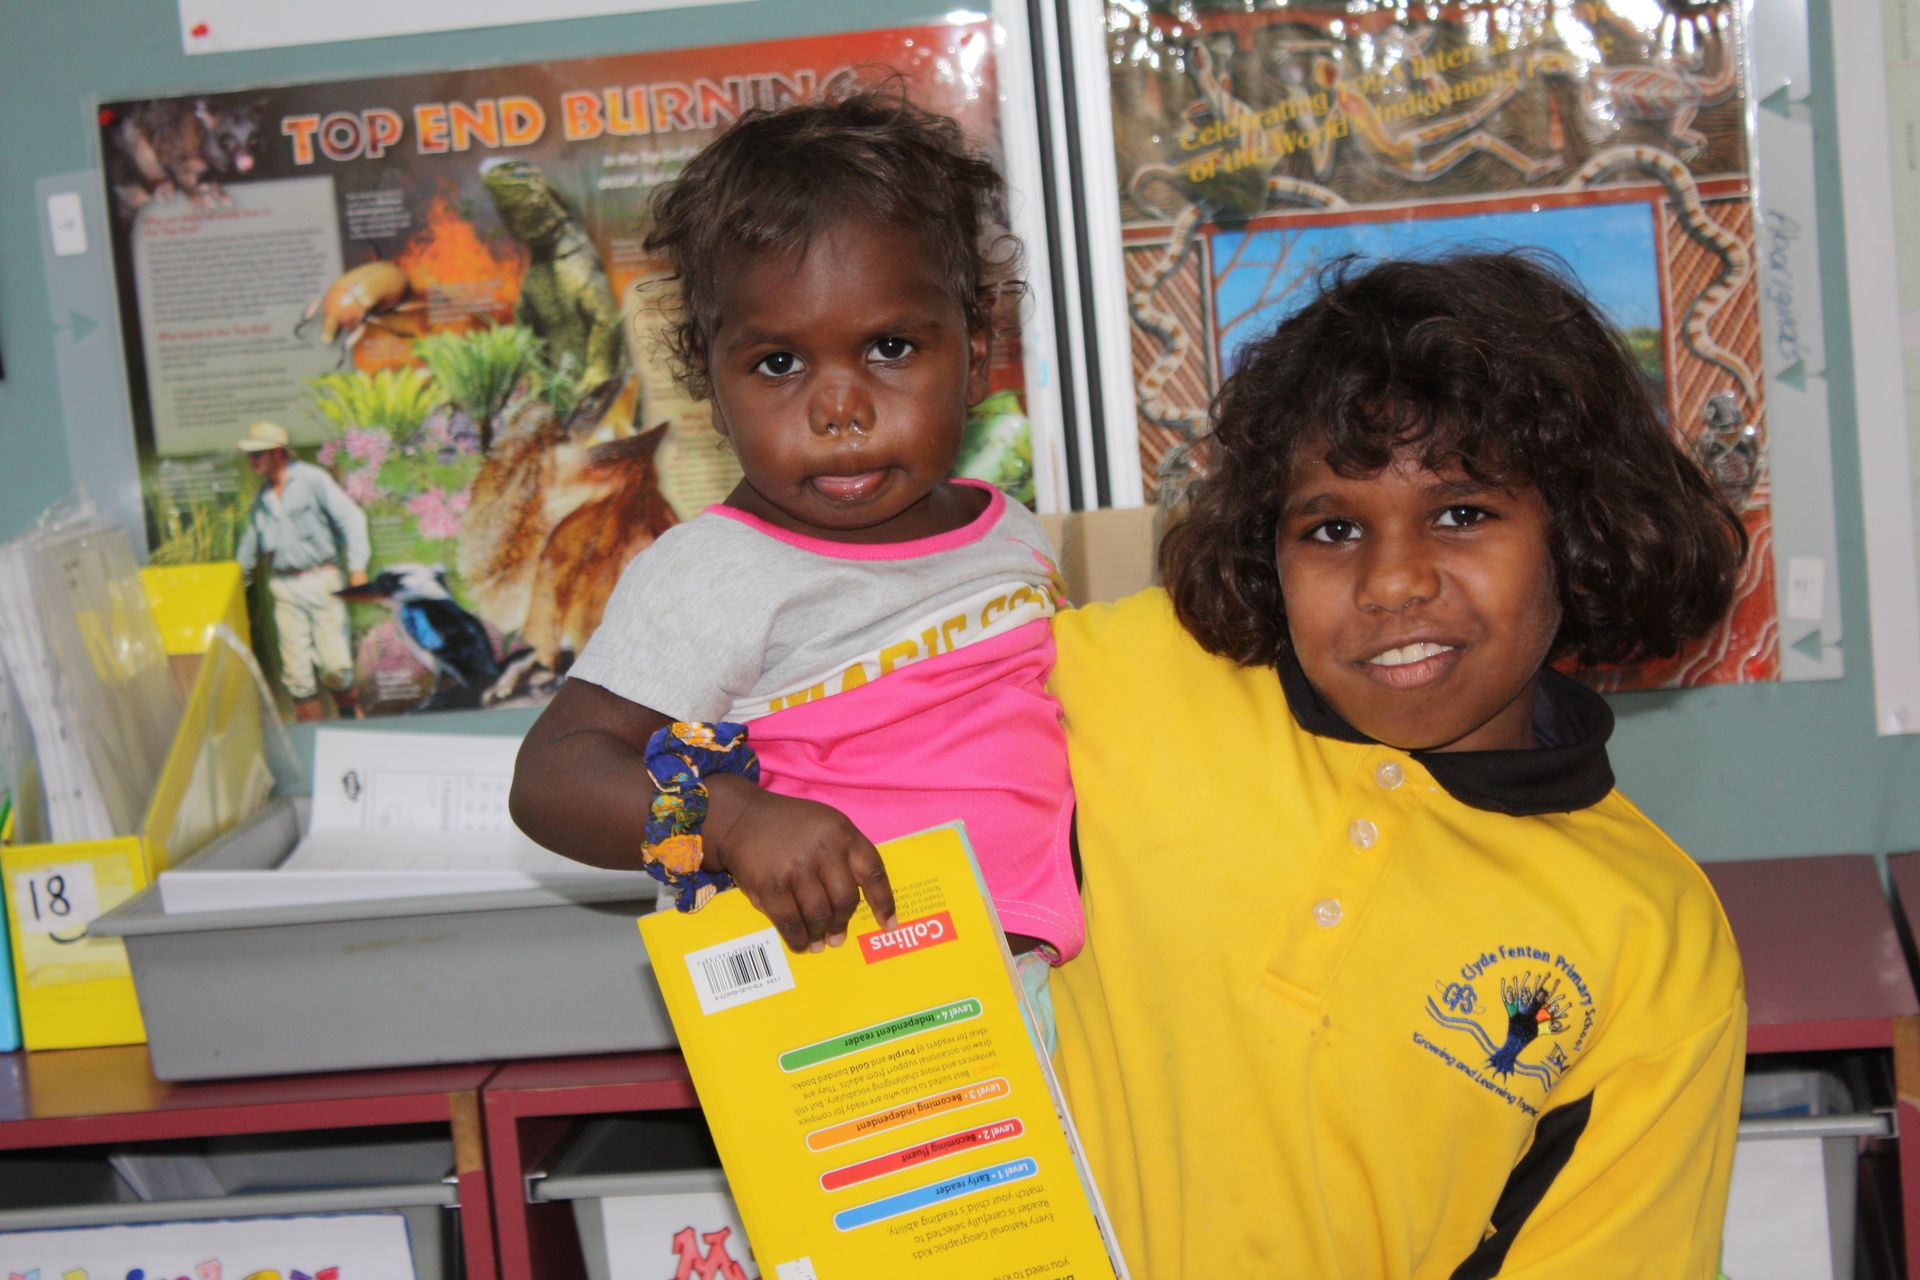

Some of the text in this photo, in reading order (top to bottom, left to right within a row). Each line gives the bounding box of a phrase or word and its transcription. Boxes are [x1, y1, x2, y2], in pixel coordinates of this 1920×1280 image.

[283, 110, 403, 164] TOP
[414, 98, 545, 154] END
[28, 874, 71, 921] 18
[870, 919, 943, 950] Collins
[1461, 945, 1596, 1051] Clyde Fenton Primary School
[843, 1003, 973, 1048] Level 4 Independent reader
[968, 1026, 987, 1038] ideal
[925, 1036, 955, 1051] readers
[957, 1031, 968, 1042] for
[914, 1043, 925, 1054] of
[960, 1044, 971, 1052] on
[973, 1039, 992, 1050] draw
[870, 1056, 887, 1067] and
[888, 1048, 915, 1061] Purple
[918, 1047, 959, 1065] occasional
[849, 1061, 870, 1074] Gold
[886, 1058, 918, 1074] support
[1413, 1032, 1456, 1066] Growing
[1456, 1061, 1478, 1078] and
[1475, 1073, 1517, 1105] Learning
[817, 1068, 848, 1083] banded
[865, 1067, 885, 1081] from
[928, 1074, 953, 1088] suited
[952, 1069, 969, 1080] Best
[793, 1050, 995, 1116] sentences and more challenging vocabulary, but still
[816, 1082, 836, 1096] They
[918, 1081, 927, 1090] to
[804, 1090, 816, 1099] are
[883, 1090, 900, 1101] who
[901, 1085, 918, 1096] kids
[846, 1101, 868, 1112] ready
[856, 1082, 1000, 1131] Level 3 Becoming independent
[868, 1095, 882, 1104] are
[798, 1109, 832, 1125] complex
[831, 1105, 845, 1117] for
[900, 1122, 1014, 1163] Level 2 Becoming fluent
[934, 1161, 1028, 1196] Level 1 Early reader
[888, 1184, 1044, 1237] match your child's reading ability.
[913, 1198, 1049, 1244] Reader is carefully selected to
[912, 1209, 1054, 1261] Every National Geographic Kids
[1025, 1262, 1049, 1277] need
[1050, 1256, 1069, 1269] you
[1013, 1270, 1023, 1280] to
